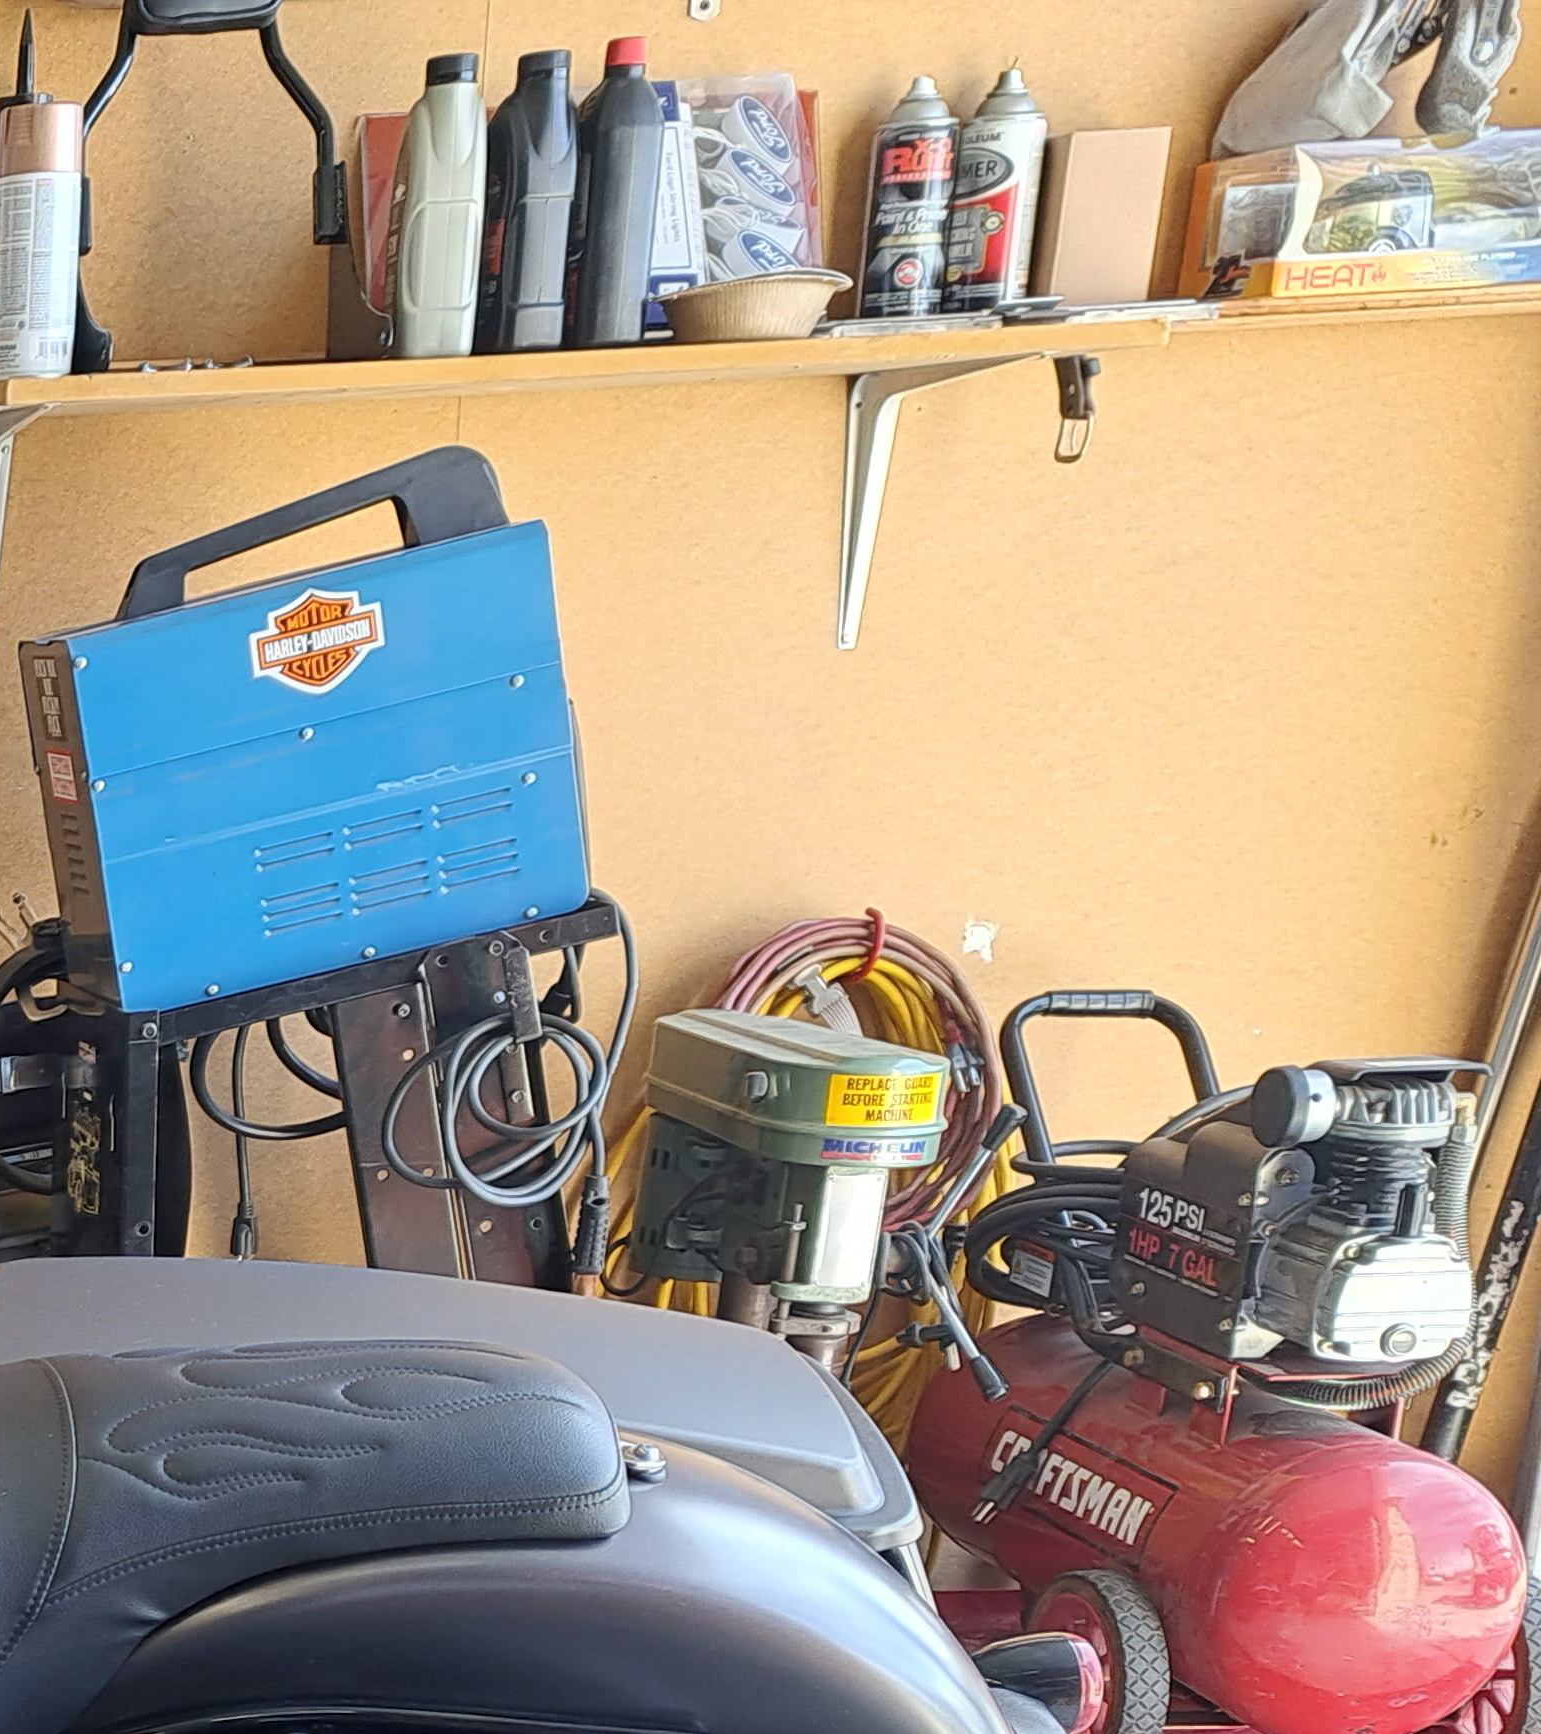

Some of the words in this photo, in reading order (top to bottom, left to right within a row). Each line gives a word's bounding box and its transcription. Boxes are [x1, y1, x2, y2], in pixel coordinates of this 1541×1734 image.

[1284, 262, 1373, 291] HEAT
[286, 602, 343, 631] MOTOR
[264, 617, 371, 663] HARLEY-DAVIDSON
[291, 649, 348, 679] CYCLES
[841, 1092, 886, 1106] BEFORE
[864, 1108, 915, 1122] MACHINE
[822, 1139, 927, 1154] MICHELIN
[1138, 1187, 1175, 1229] 125
[1174, 1199, 1206, 1232] PSI
[1128, 1227, 1161, 1261] 1HP
[1168, 1242, 1182, 1269] 7
[1181, 1249, 1218, 1288] GAL
